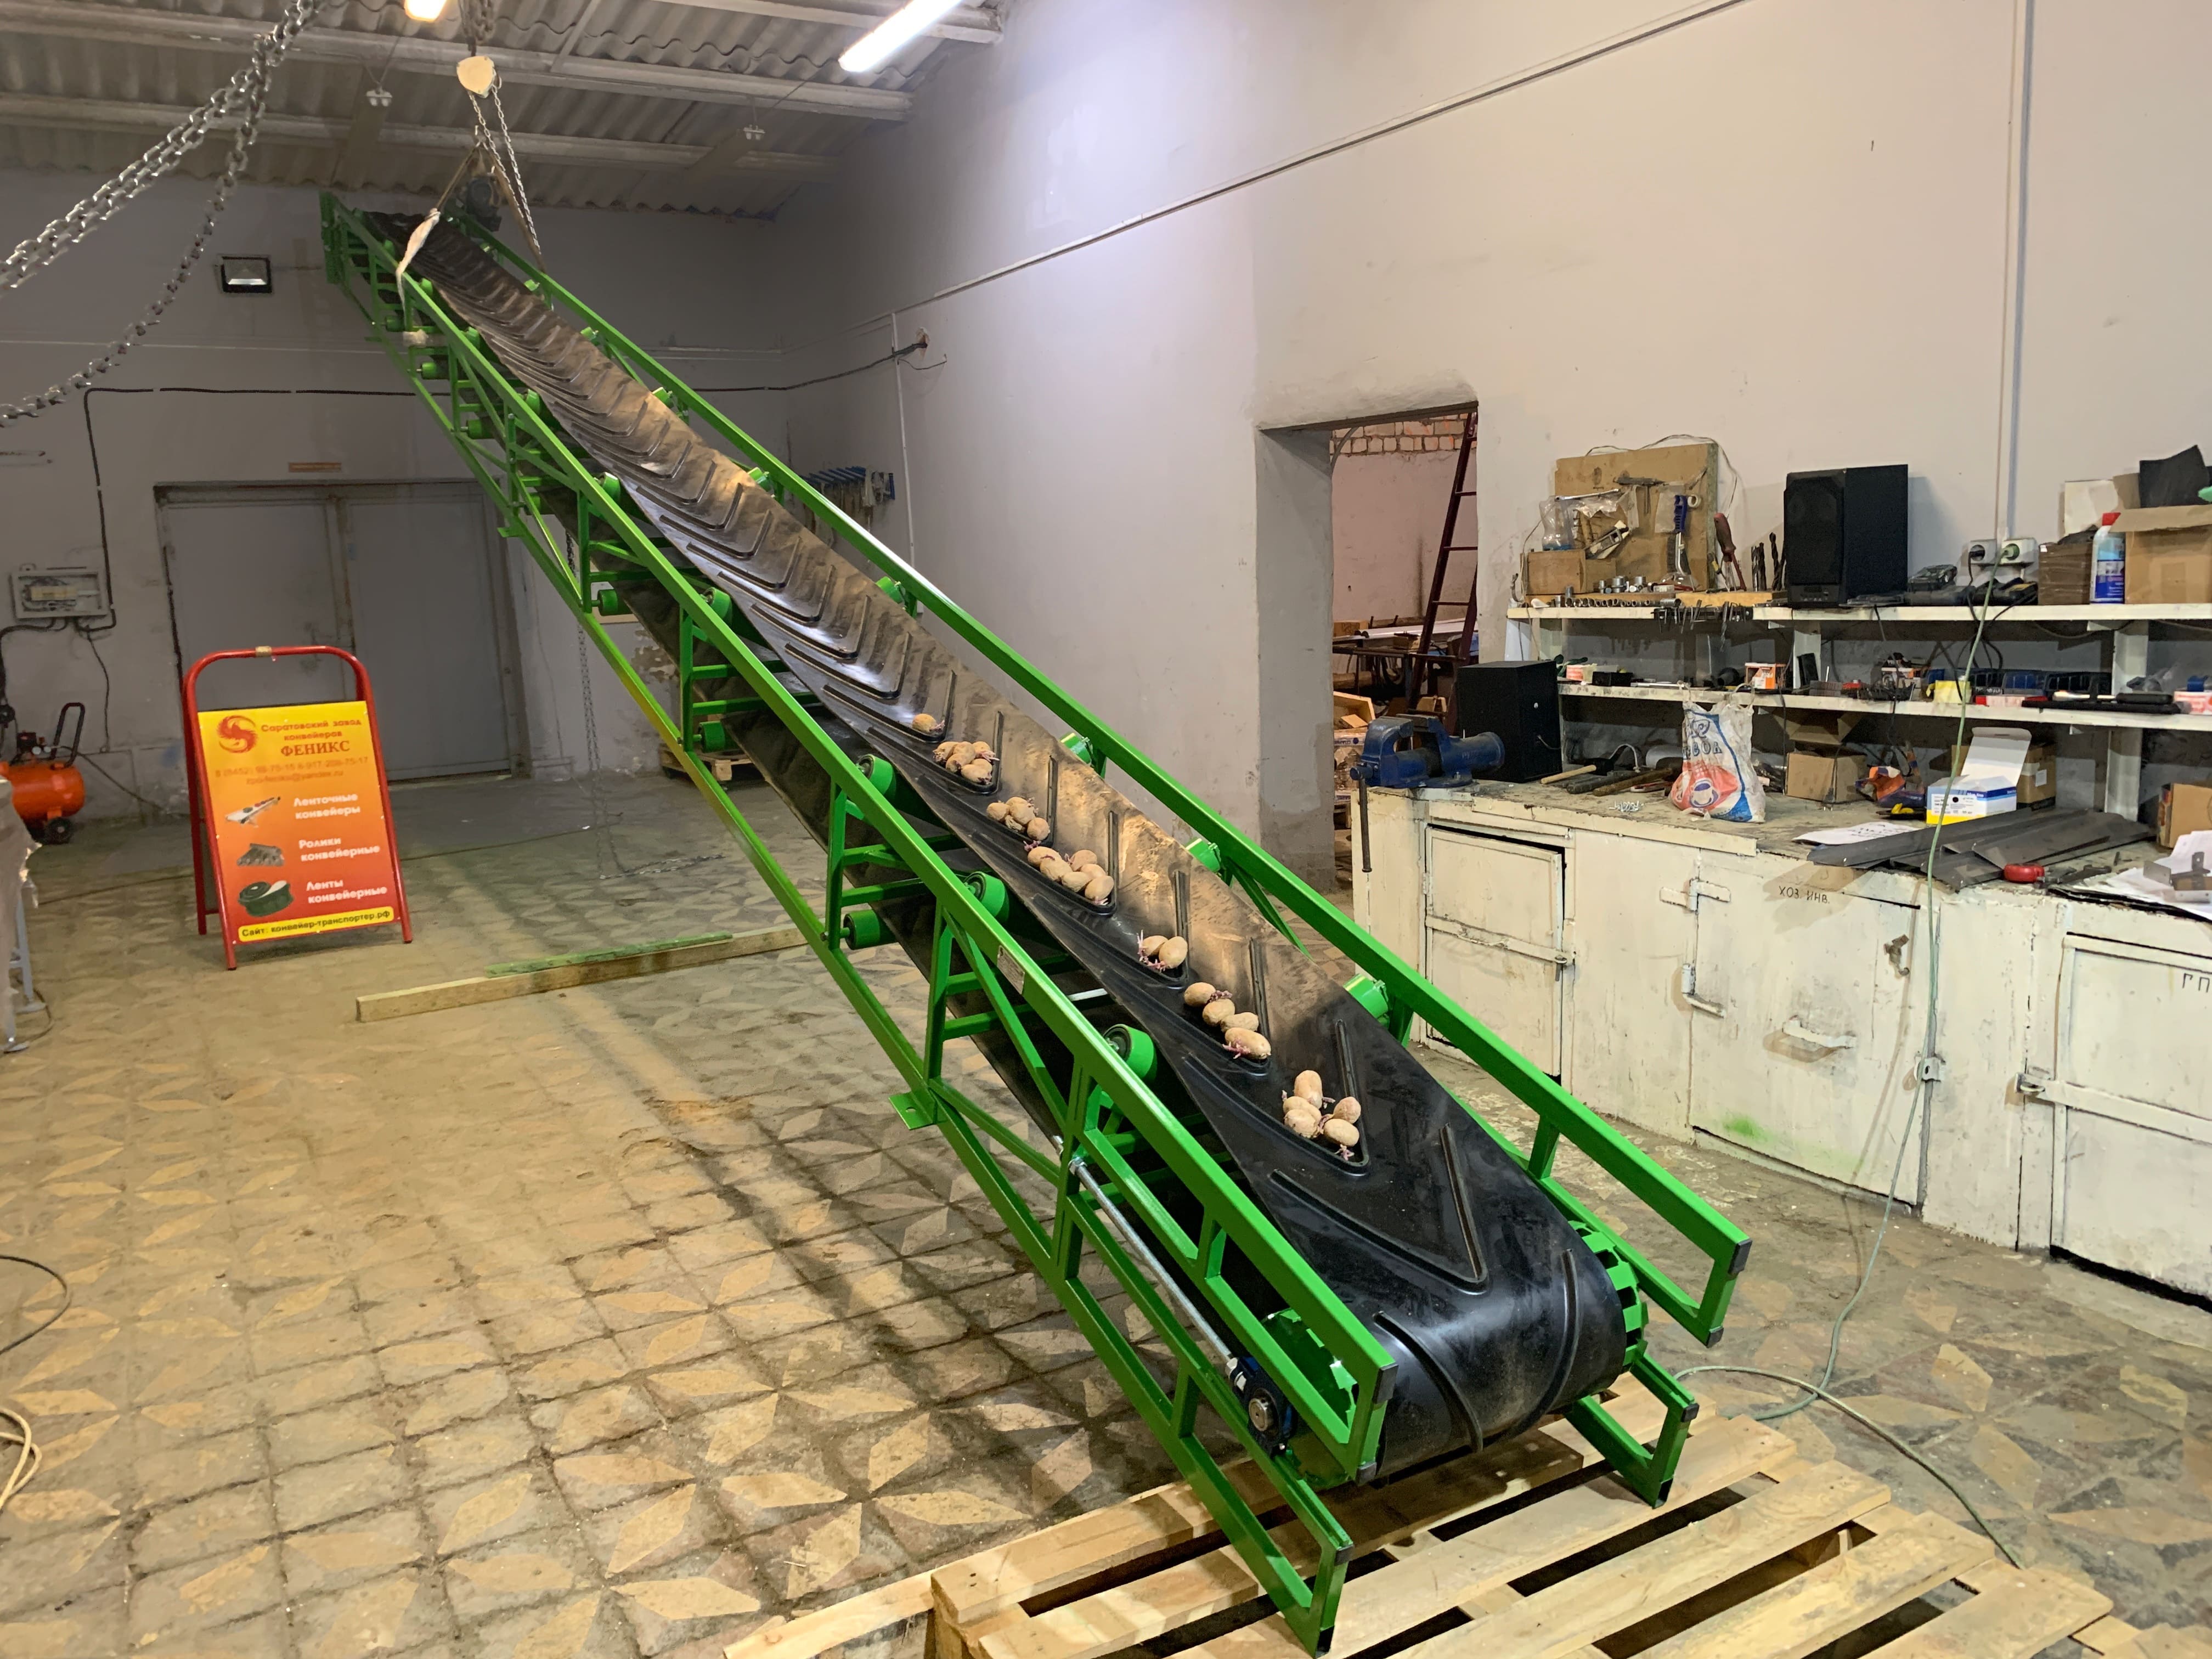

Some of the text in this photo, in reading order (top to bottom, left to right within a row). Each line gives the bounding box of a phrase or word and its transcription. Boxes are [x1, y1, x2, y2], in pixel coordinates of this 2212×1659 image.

[261, 720, 329, 732] Саратовский
[284, 731, 342, 741] конвейеров
[280, 740, 350, 757] ФЕНИКС
[294, 794, 358, 806] Ленточные
[295, 806, 360, 819] конвейеры
[298, 838, 341, 849] Ролики
[301, 845, 380, 862] конвейерные
[306, 880, 343, 891] Ленты
[308, 886, 387, 904] конвейерные
